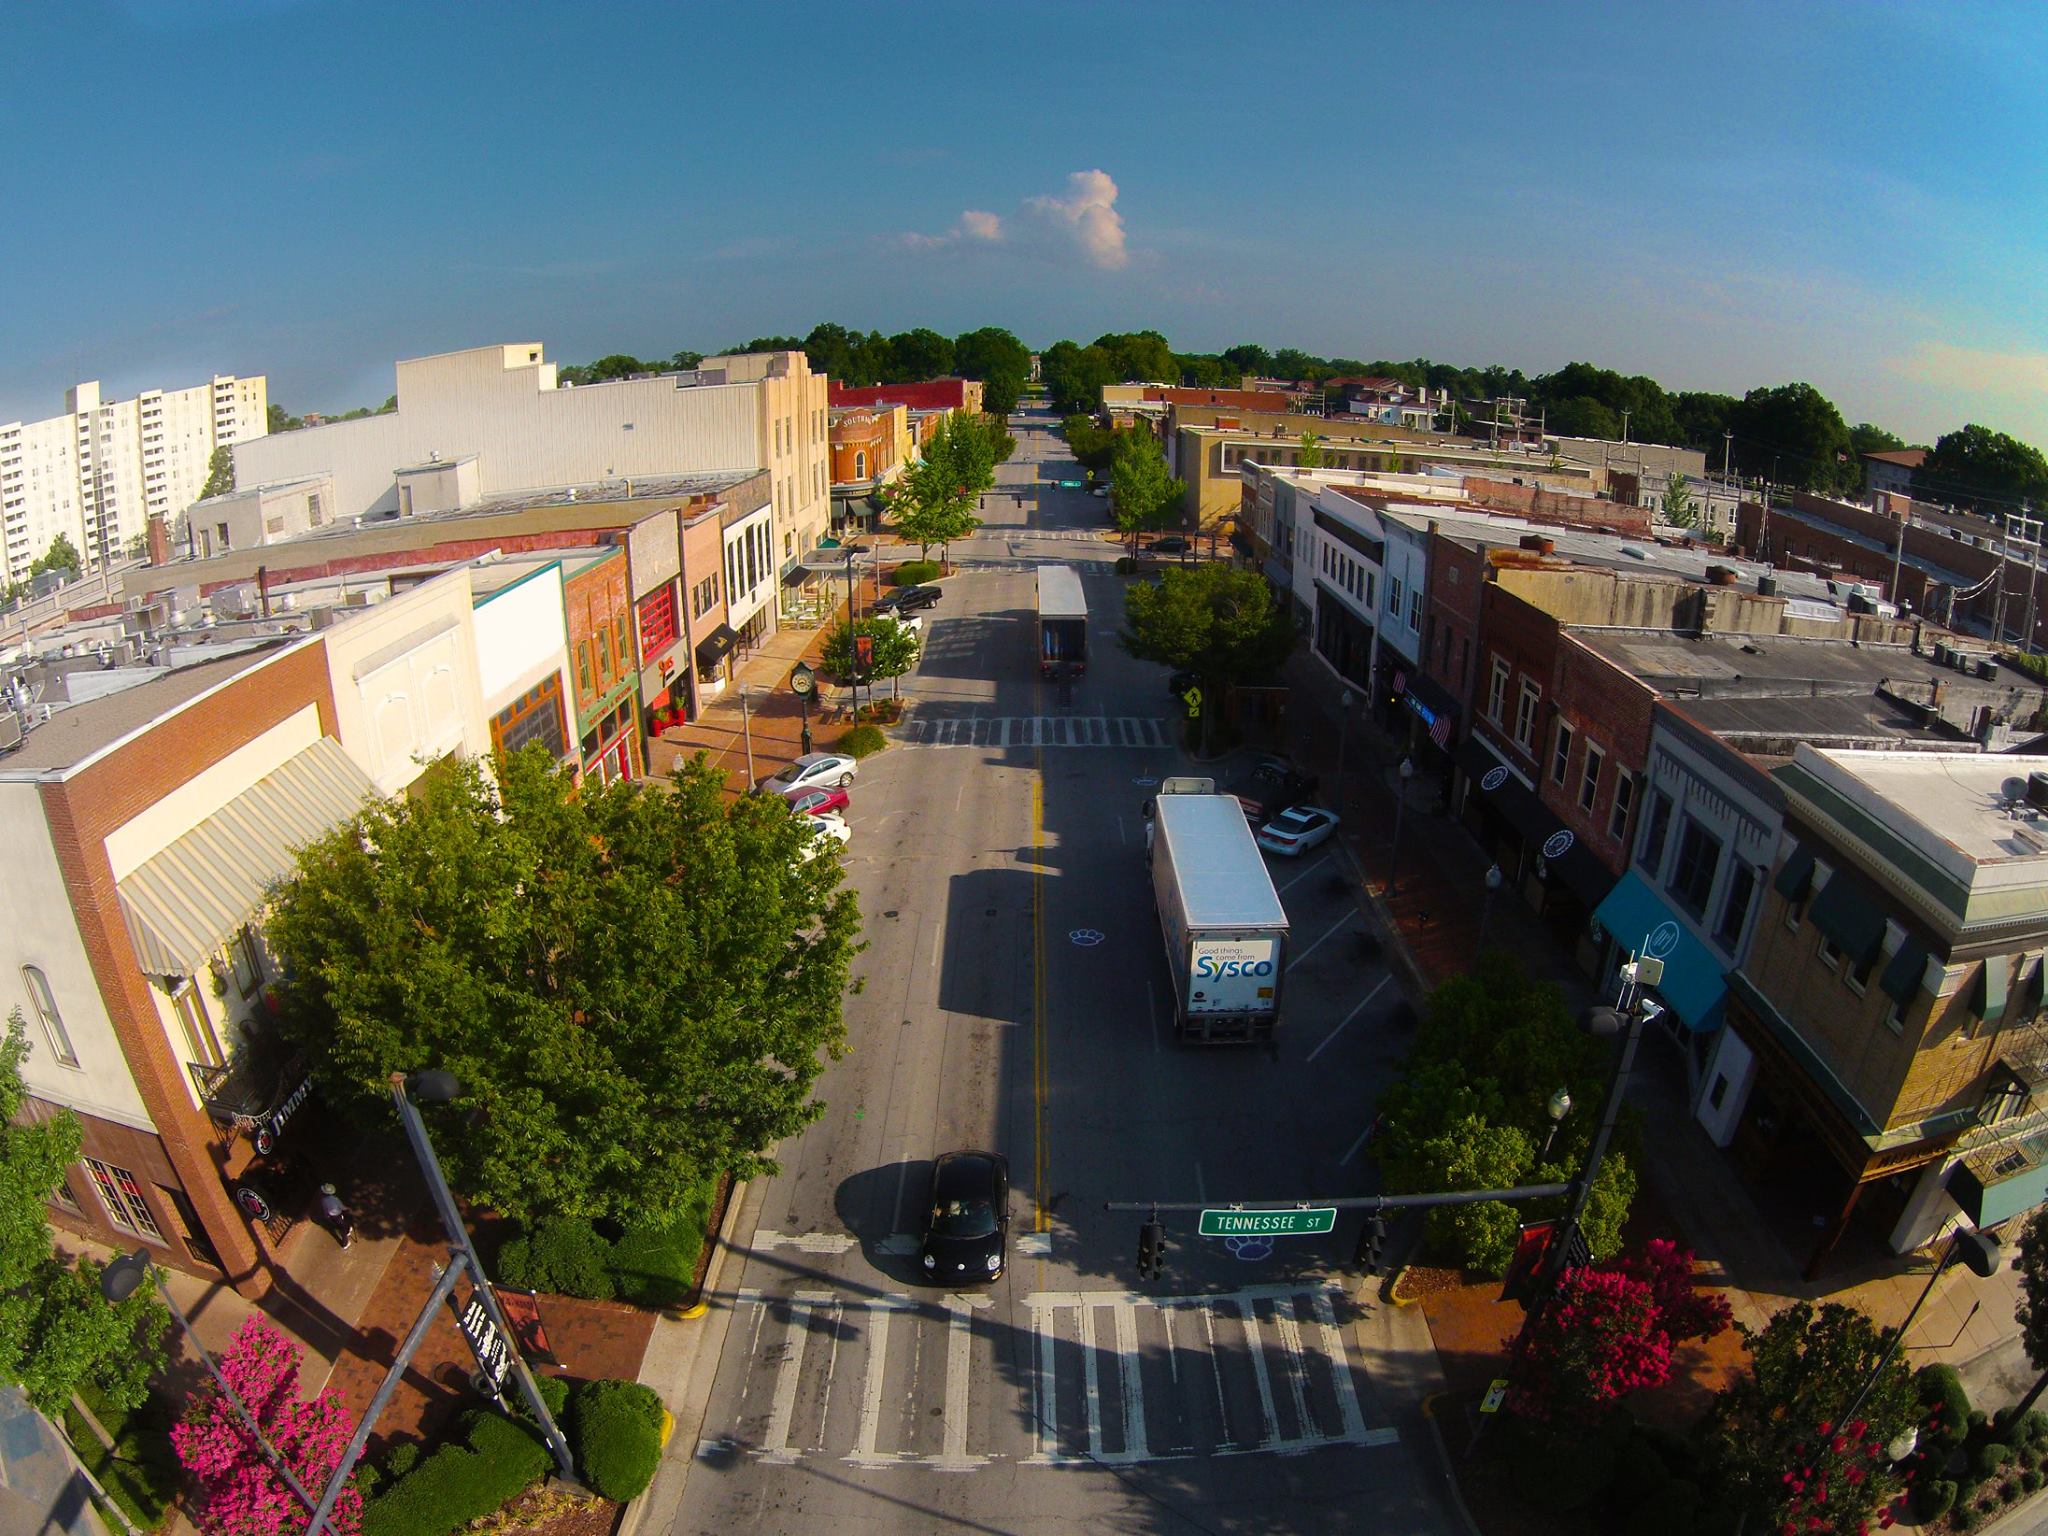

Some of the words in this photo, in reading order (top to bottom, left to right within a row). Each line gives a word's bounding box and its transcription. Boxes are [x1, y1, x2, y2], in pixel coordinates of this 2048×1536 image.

[1199, 947, 1219, 955] Good
[1220, 947, 1243, 955] things
[1196, 956, 1273, 983] Sysco
[270, 1076, 313, 1137] JIMMY
[1217, 1216, 1296, 1230] TENNESSEE
[1306, 1217, 1321, 1228] ST
